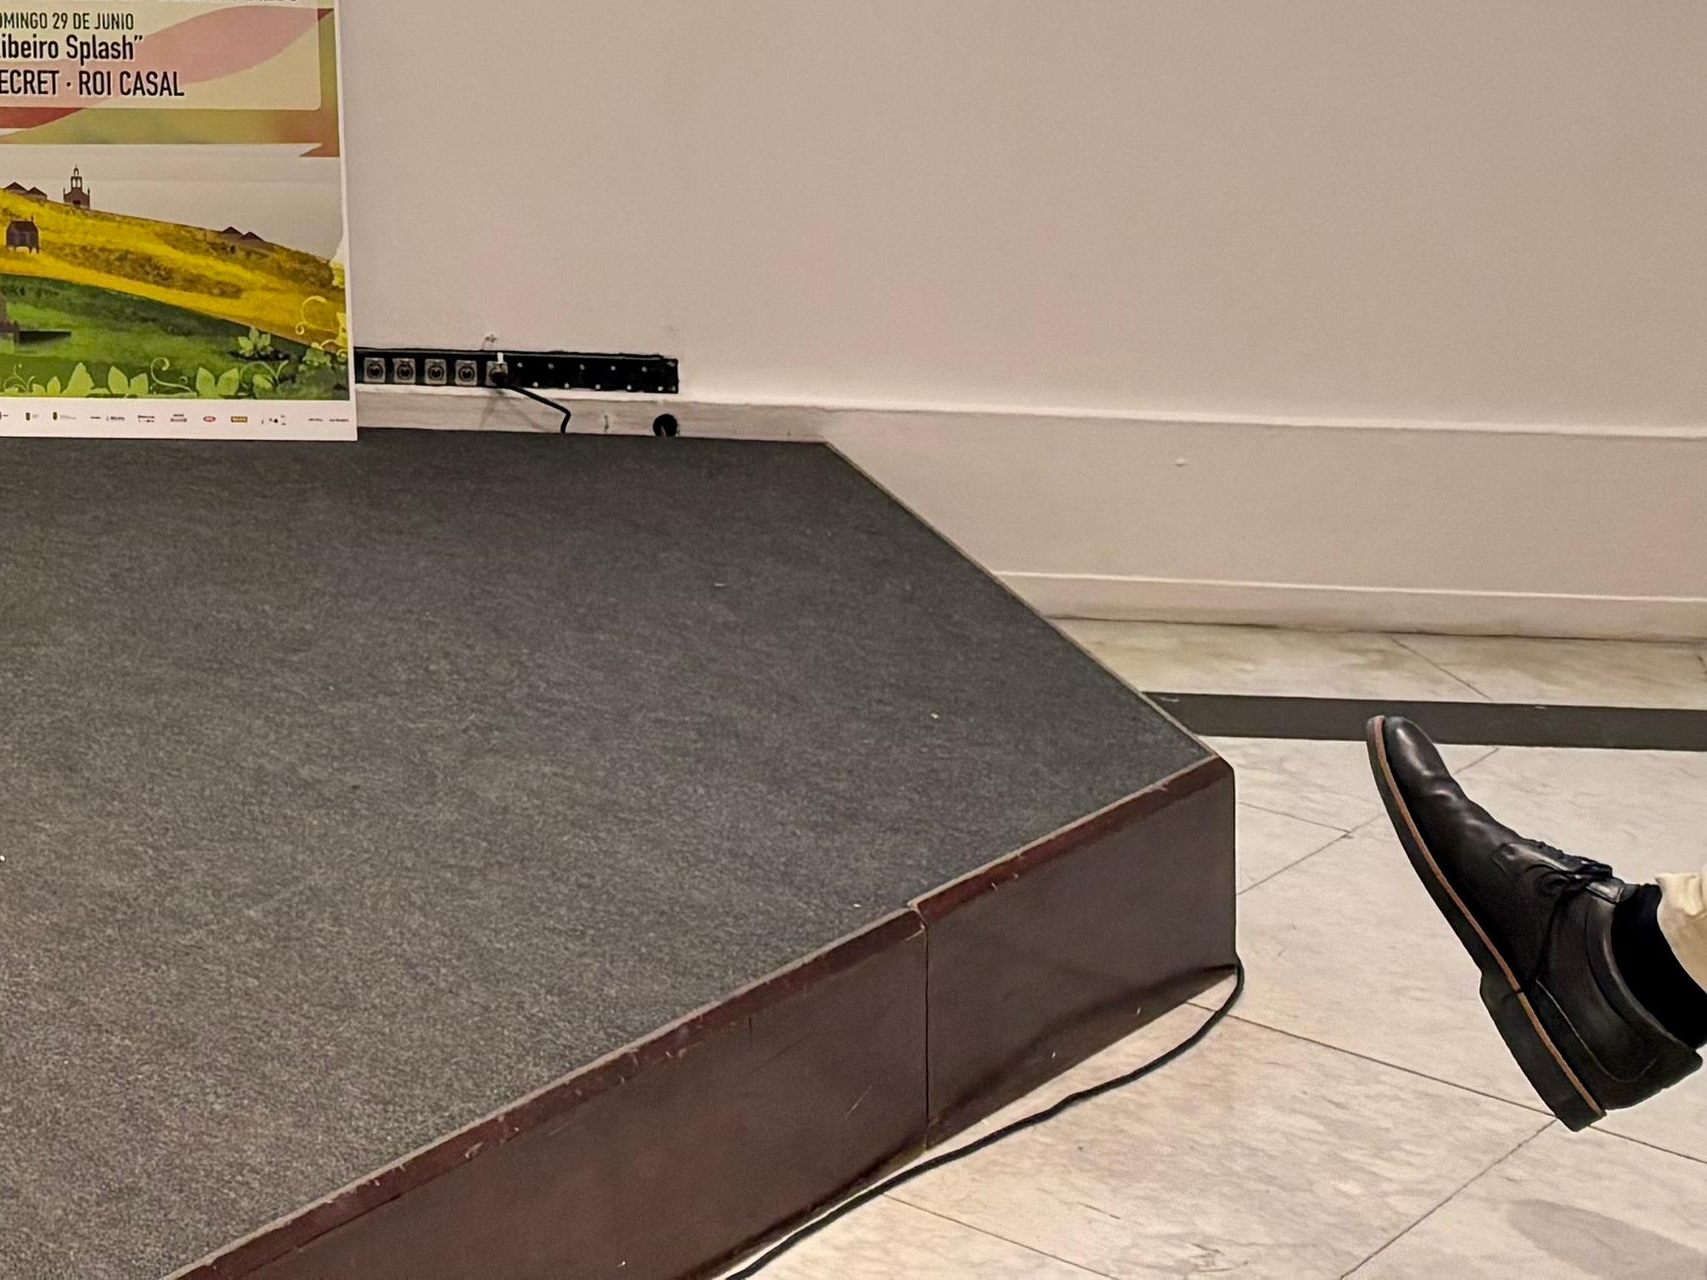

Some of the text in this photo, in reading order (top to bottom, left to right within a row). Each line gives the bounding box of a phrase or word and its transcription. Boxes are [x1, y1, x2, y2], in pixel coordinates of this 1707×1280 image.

[53, 12, 68, 30] 29
[72, 13, 89, 30] DE
[93, 13, 134, 30] JUNIO
[79, 71, 113, 96] ROI
[119, 72, 184, 97] CASAL
